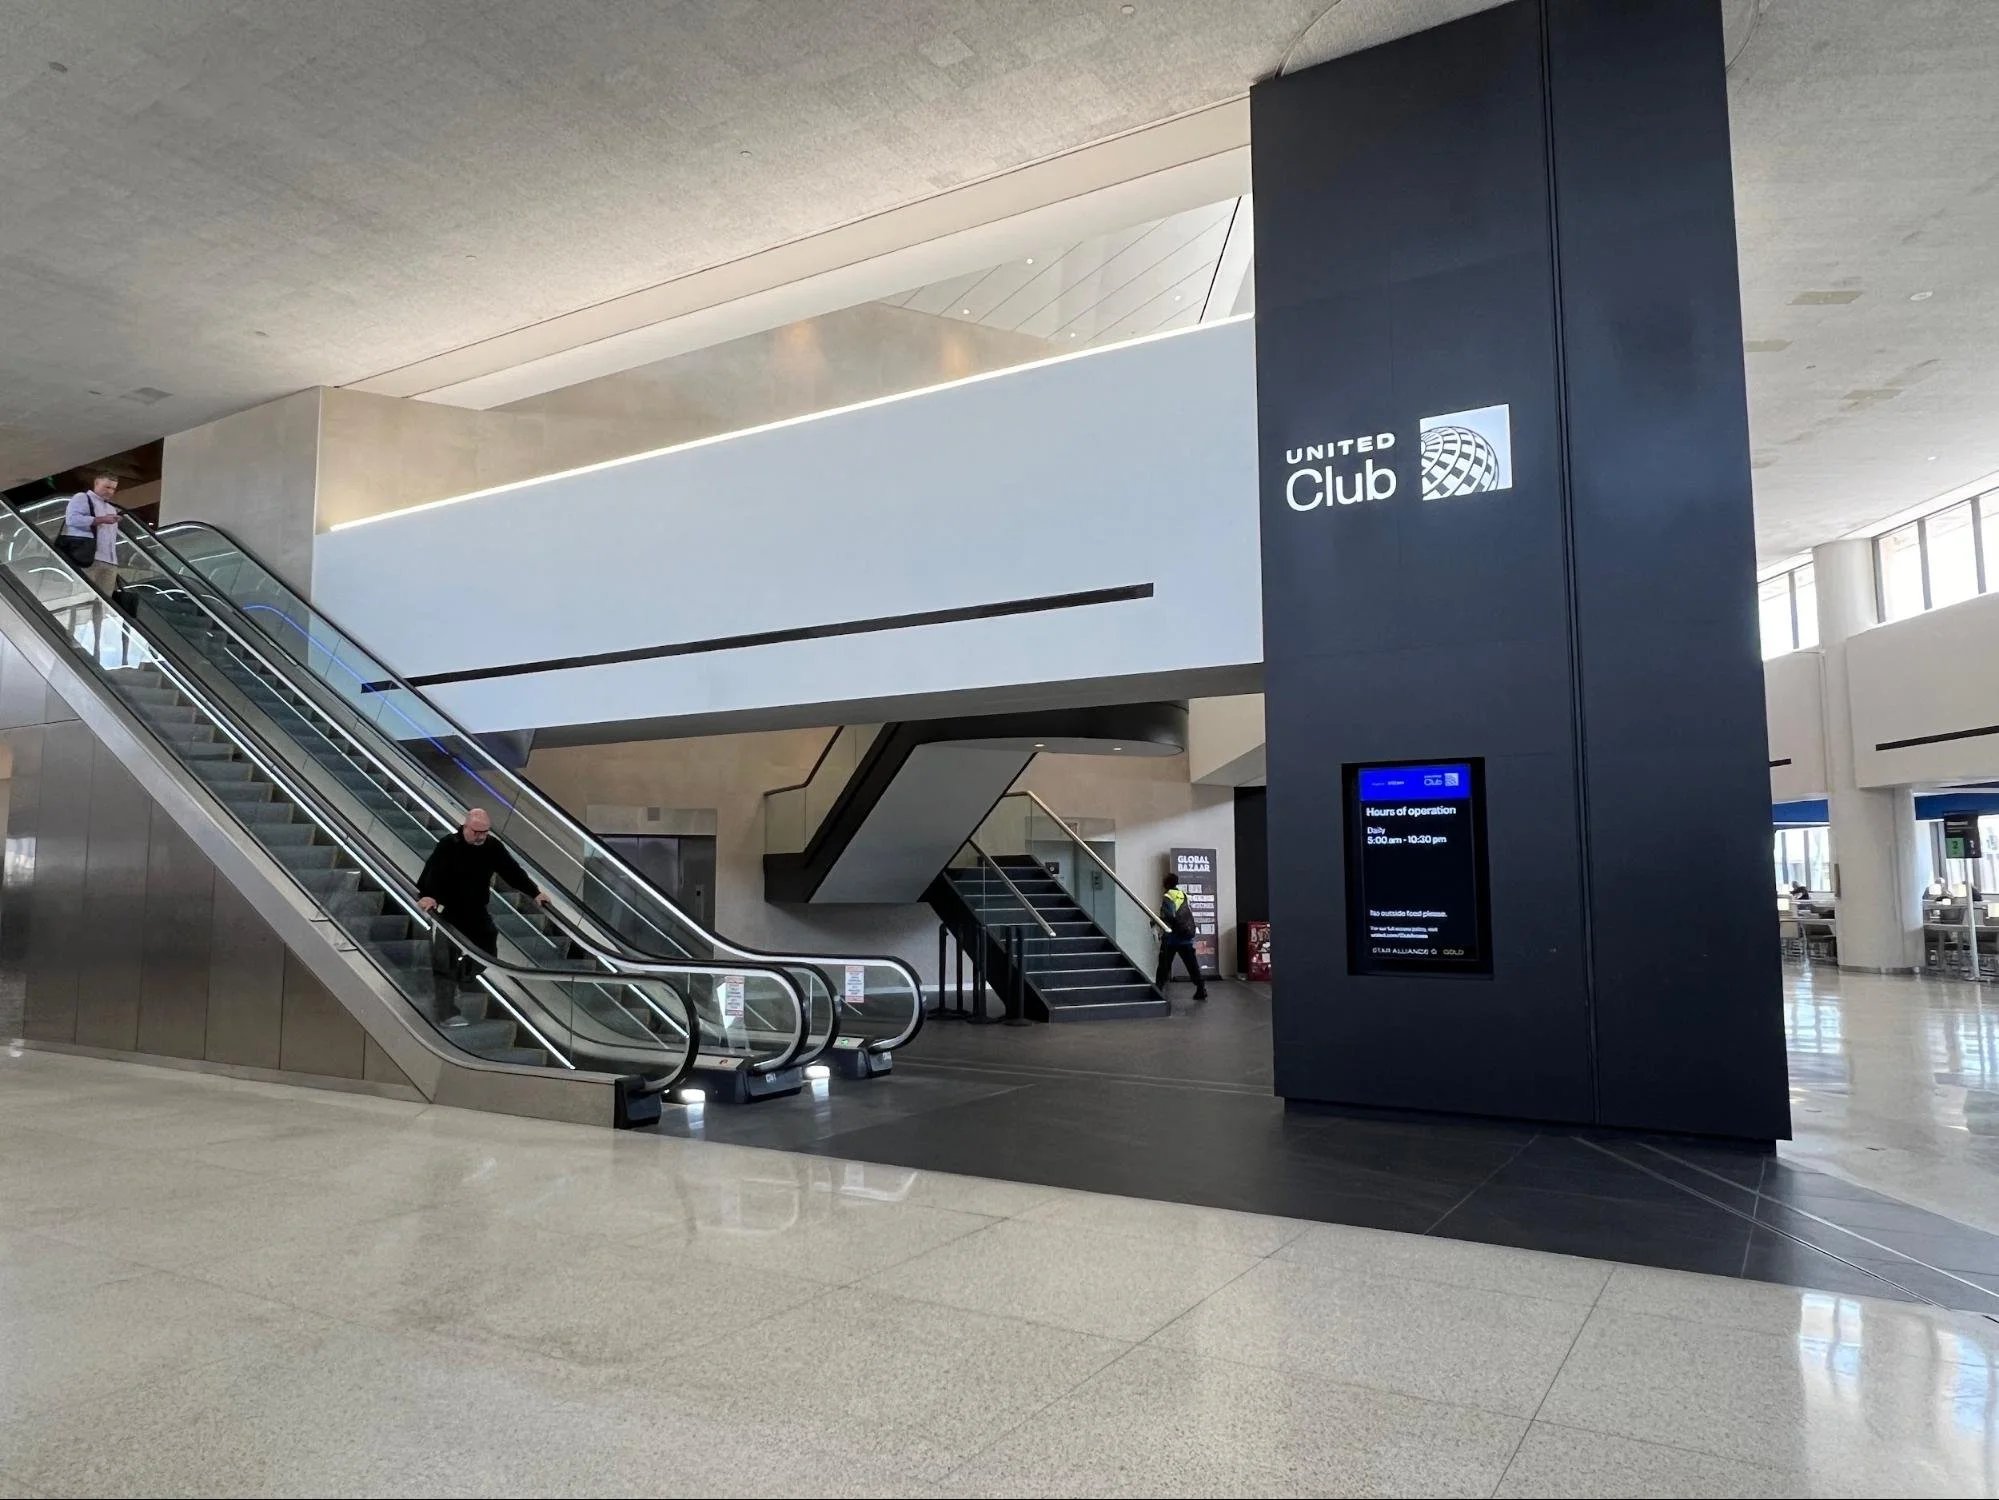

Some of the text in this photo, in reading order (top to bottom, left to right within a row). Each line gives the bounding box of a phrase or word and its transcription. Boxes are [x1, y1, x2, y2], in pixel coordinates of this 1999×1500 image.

[1286, 432, 1396, 465] UNITED
[1286, 458, 1397, 512] Club
[1366, 805, 1457, 817] Hours of operation
[1367, 826, 1386, 835] Daily
[1367, 836, 1388, 845] 5:00
[1388, 837, 1402, 845] am
[1408, 835, 1431, 844] 10:30
[1432, 836, 1447, 845] pm
[1177, 855, 1209, 864] GLOBAL
[1177, 863, 1210, 872] BAZAAR
